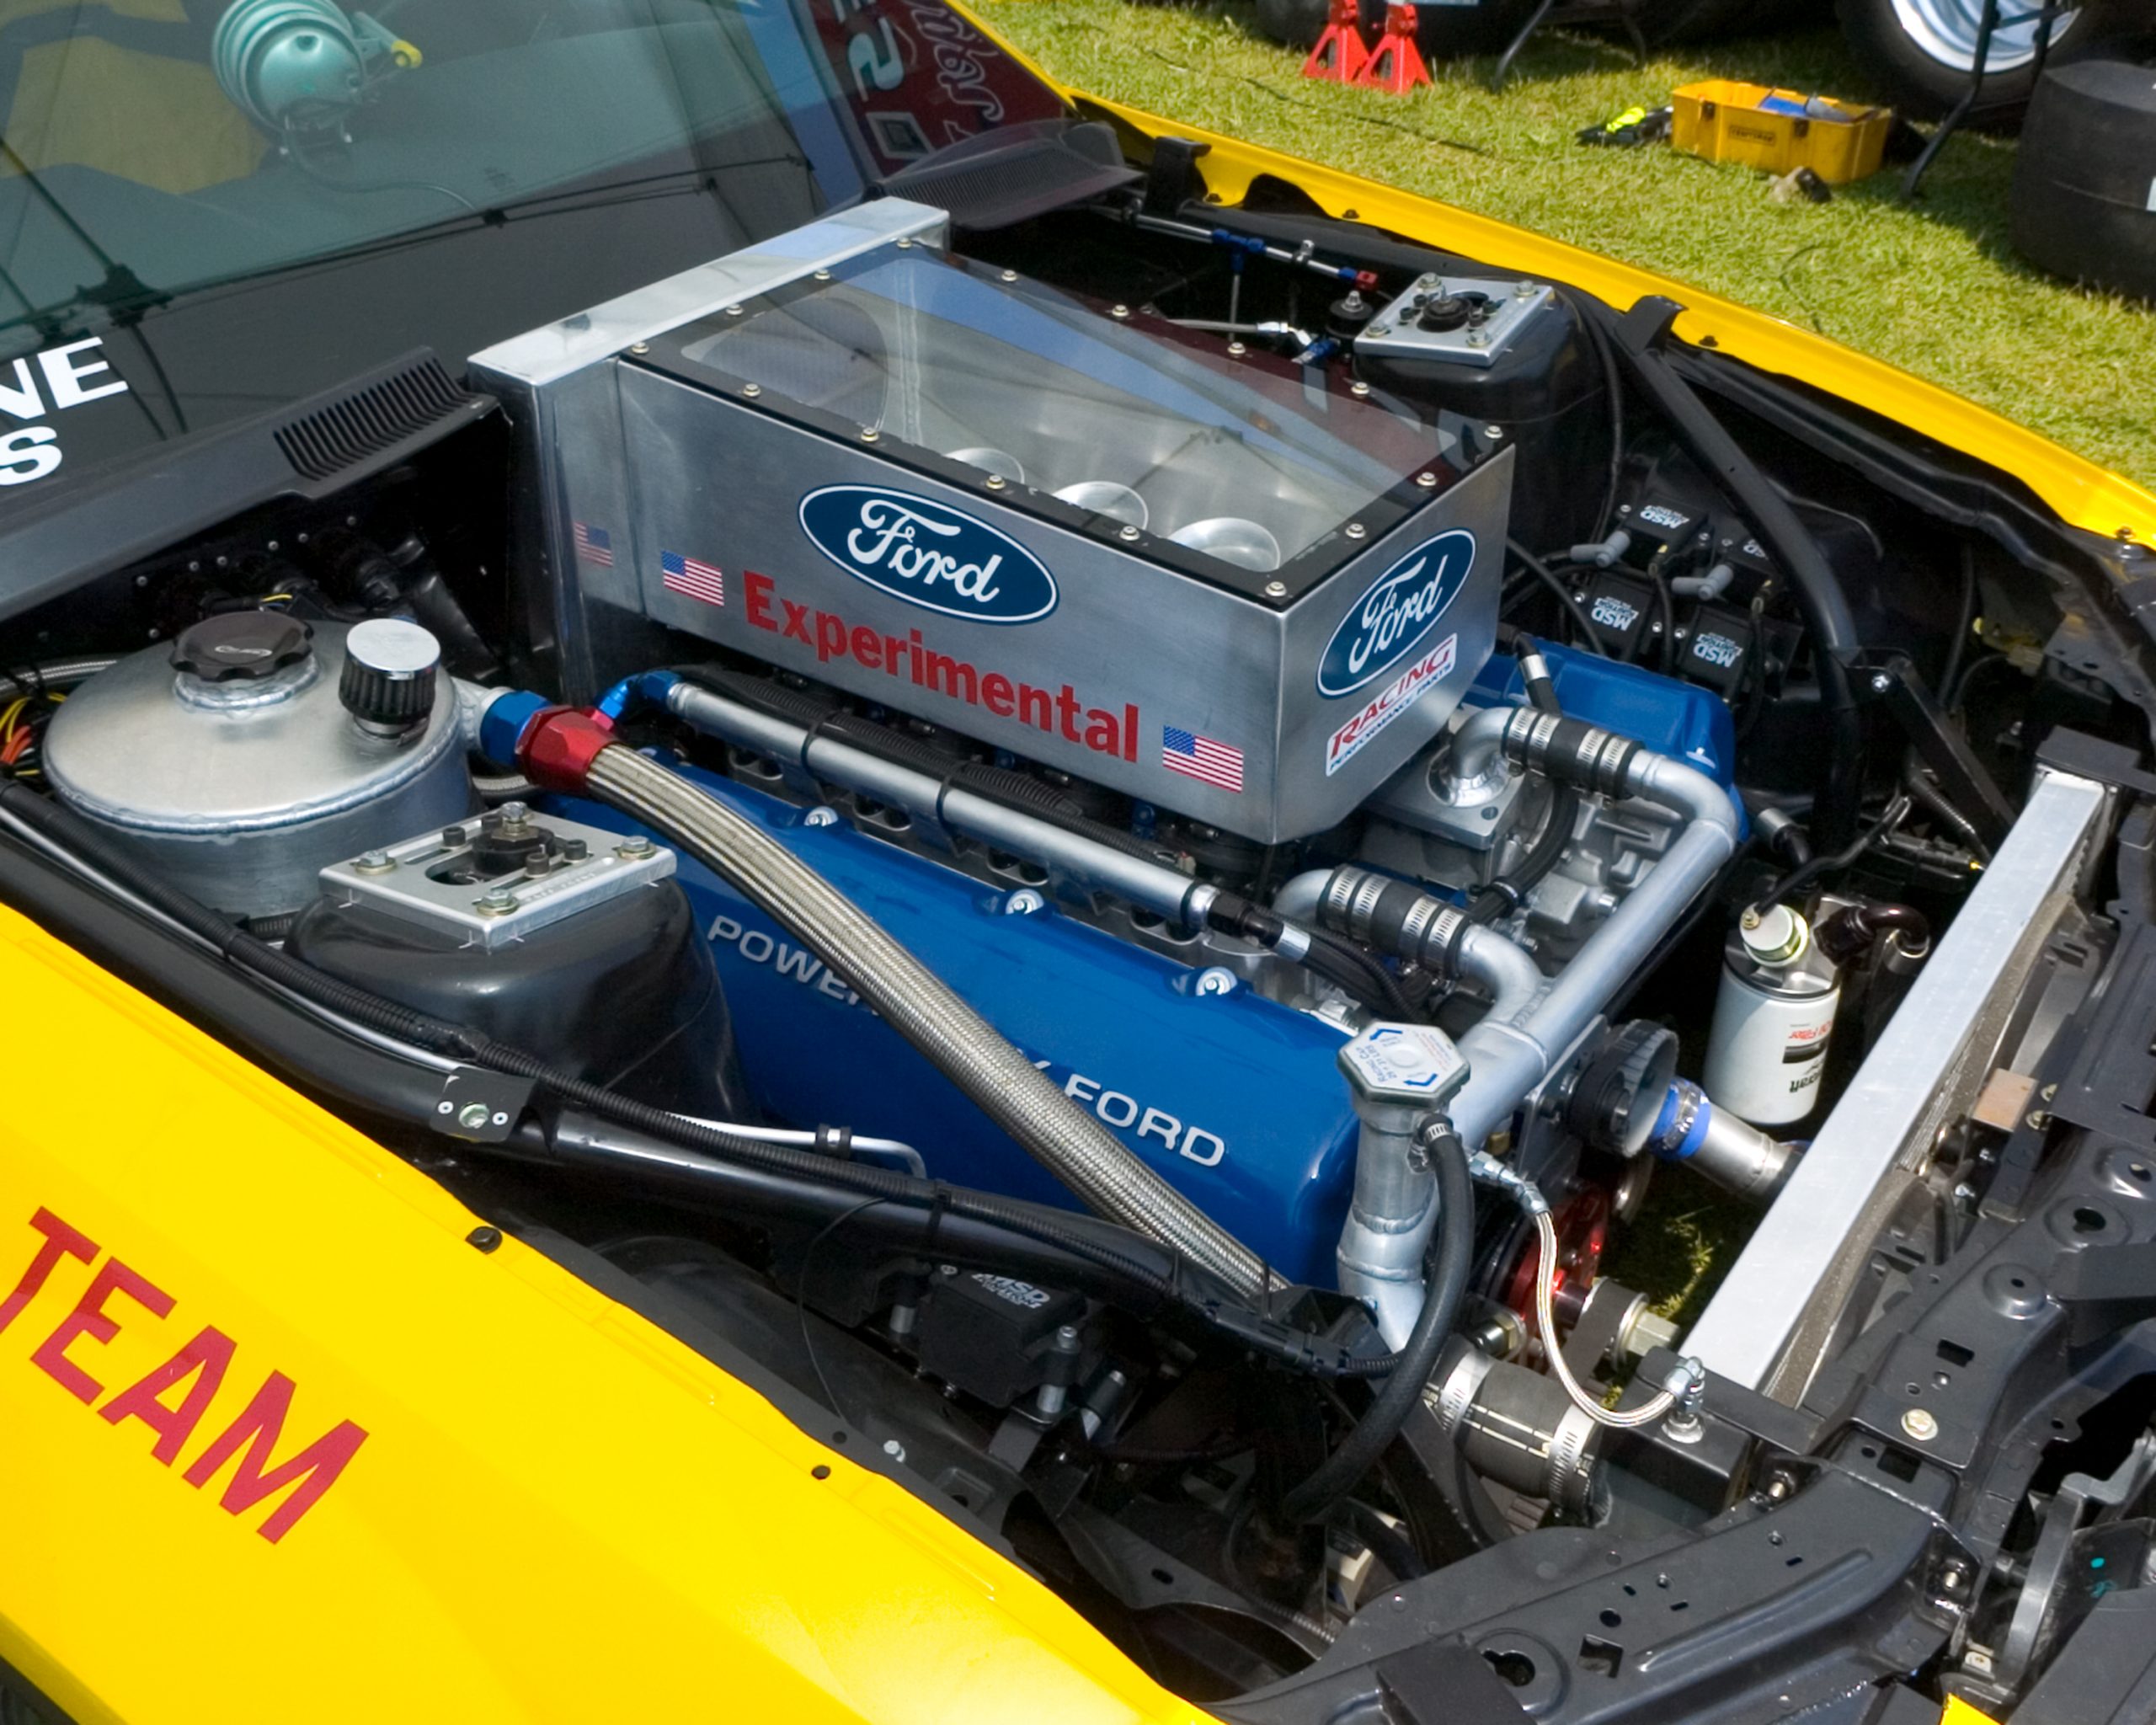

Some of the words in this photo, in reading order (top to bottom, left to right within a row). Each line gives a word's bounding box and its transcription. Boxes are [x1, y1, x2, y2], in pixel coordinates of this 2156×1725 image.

[846, 499, 1003, 603] Ford
[744, 571, 1139, 762] Experimental
[1349, 553, 1449, 674] Ford
[1591, 606, 1633, 631] MSD
[1693, 643, 1736, 668] MSD
[1330, 695, 1412, 771] PERFORMANCE
[1417, 662, 1452, 696] PARTS
[1331, 638, 1454, 760] RACING
[1064, 1073, 1225, 1167] FORD
[0, 1205, 370, 1545] TEAM
